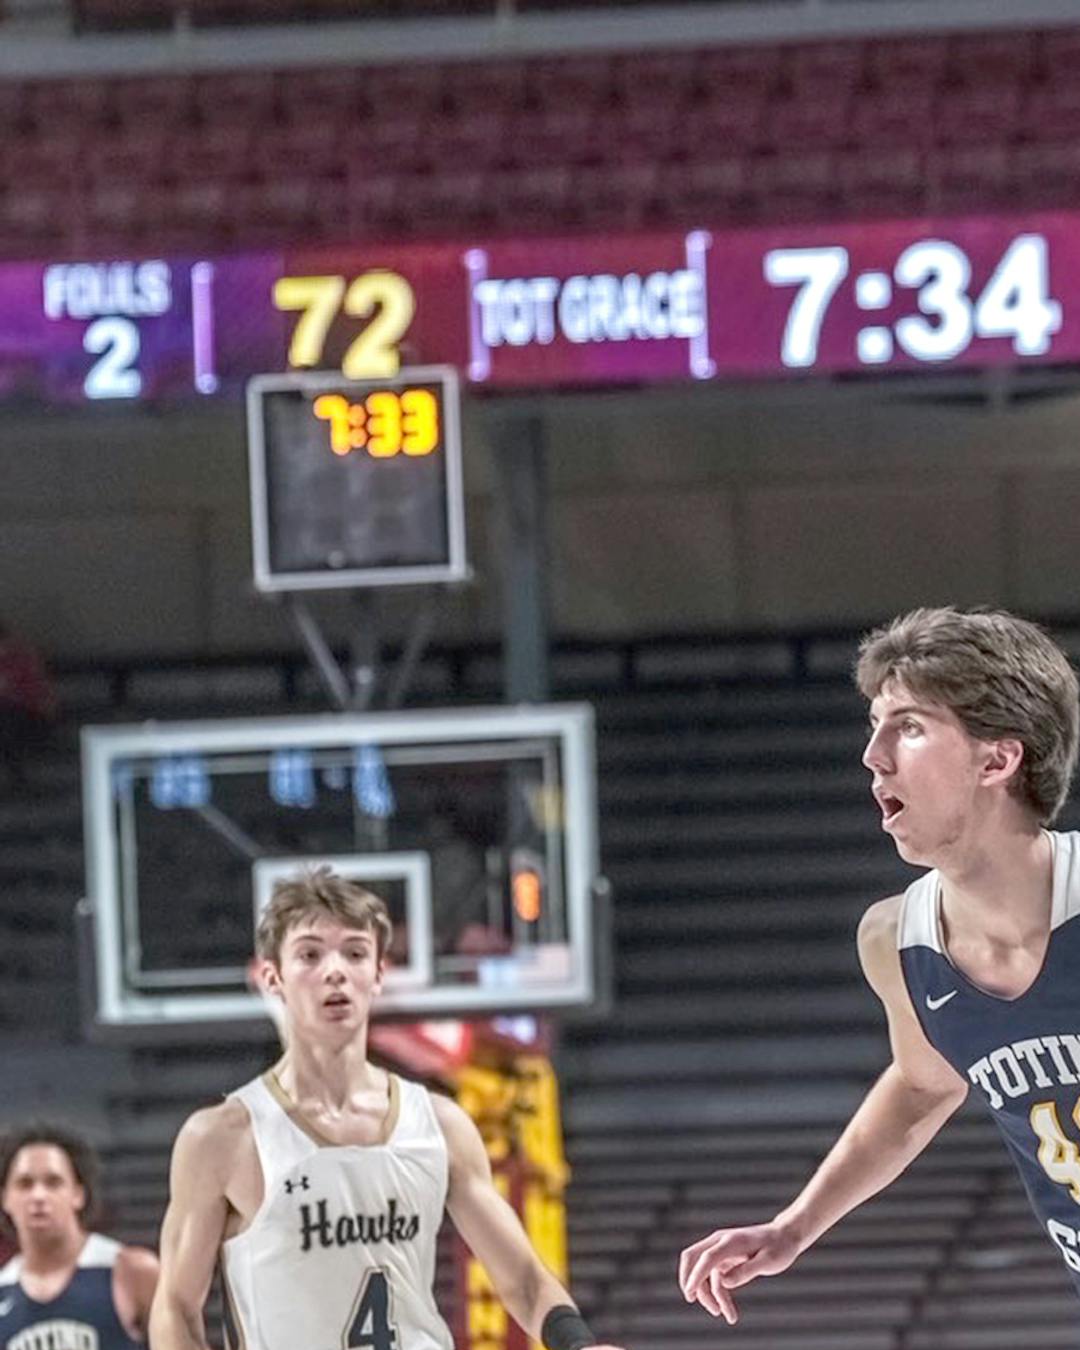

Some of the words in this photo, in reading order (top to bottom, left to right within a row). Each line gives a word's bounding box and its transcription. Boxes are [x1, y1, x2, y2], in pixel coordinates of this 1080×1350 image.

[43, 259, 172, 321] FOULS
[274, 269, 415, 380] 72
[474, 277, 560, 347] TOT
[559, 271, 704, 343] GRACE
[763, 233, 1062, 367] 7:34
[83, 315, 142, 400] 2
[313, 389, 438, 458] 7:33
[299, 1199, 420, 1253] Hawks
